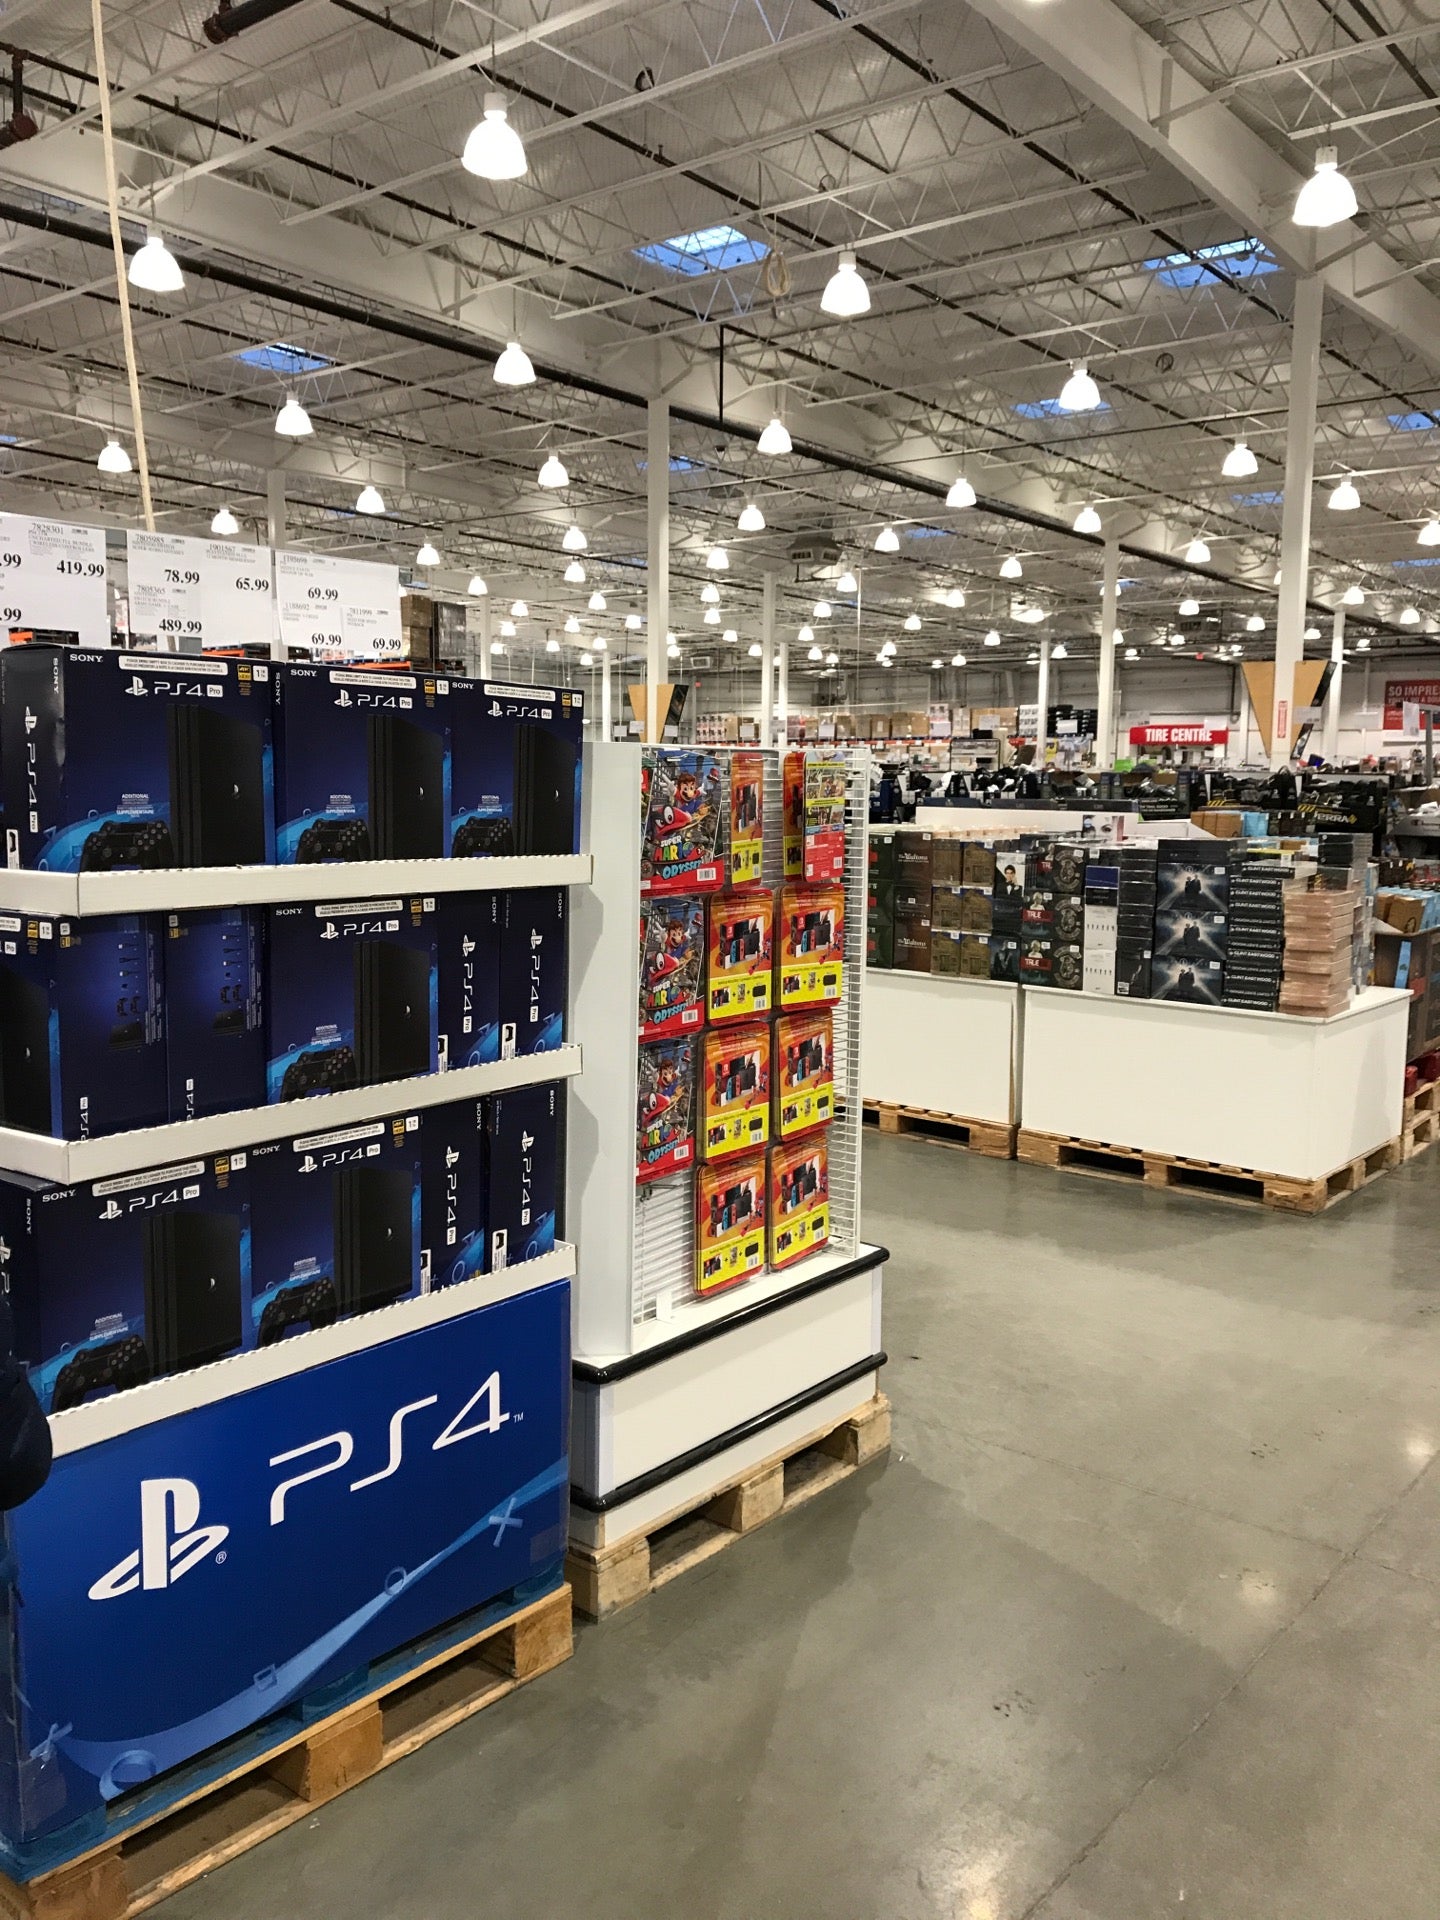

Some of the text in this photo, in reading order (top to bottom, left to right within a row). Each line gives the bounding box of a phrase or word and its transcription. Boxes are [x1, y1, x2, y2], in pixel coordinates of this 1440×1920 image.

[56, 559, 105, 578] 419.99
[164, 569, 200, 585] 78.99
[235, 577, 270, 592] 65.99
[308, 587, 339, 601] 69.99
[159, 618, 203, 634] 489.99
[311, 633, 342, 646] 69.99
[372, 638, 402, 651] 69.99
[69, 653, 103, 663] SONY
[290, 668, 317, 678] SONY
[153, 681, 203, 697] PS4
[451, 681, 475, 690] SONY
[1388, 685, 1440, 697] SO IMPRE
[357, 693, 397, 708] PS4
[506, 705, 540, 719] PS4
[1145, 728, 1213, 743] TIRE CENTRE
[27, 742, 37, 808] PS4
[660, 835, 682, 848] SUPER
[662, 859, 702, 880] ODYSSEY
[275, 908, 303, 916] SONY
[343, 921, 384, 936] PS4
[530, 954, 541, 1003] PS4
[463, 962, 473, 1013] PS4
[652, 980, 671, 993] SUPER
[252, 1144, 280, 1156] SONY
[322, 1147, 364, 1168] PS4
[521, 1156, 532, 1207] PS4
[42, 1189, 76, 1203] SONY
[128, 1189, 179, 1213] PS4
[446, 1172, 457, 1227] PS4
[269, 1370, 511, 1527] PS4
